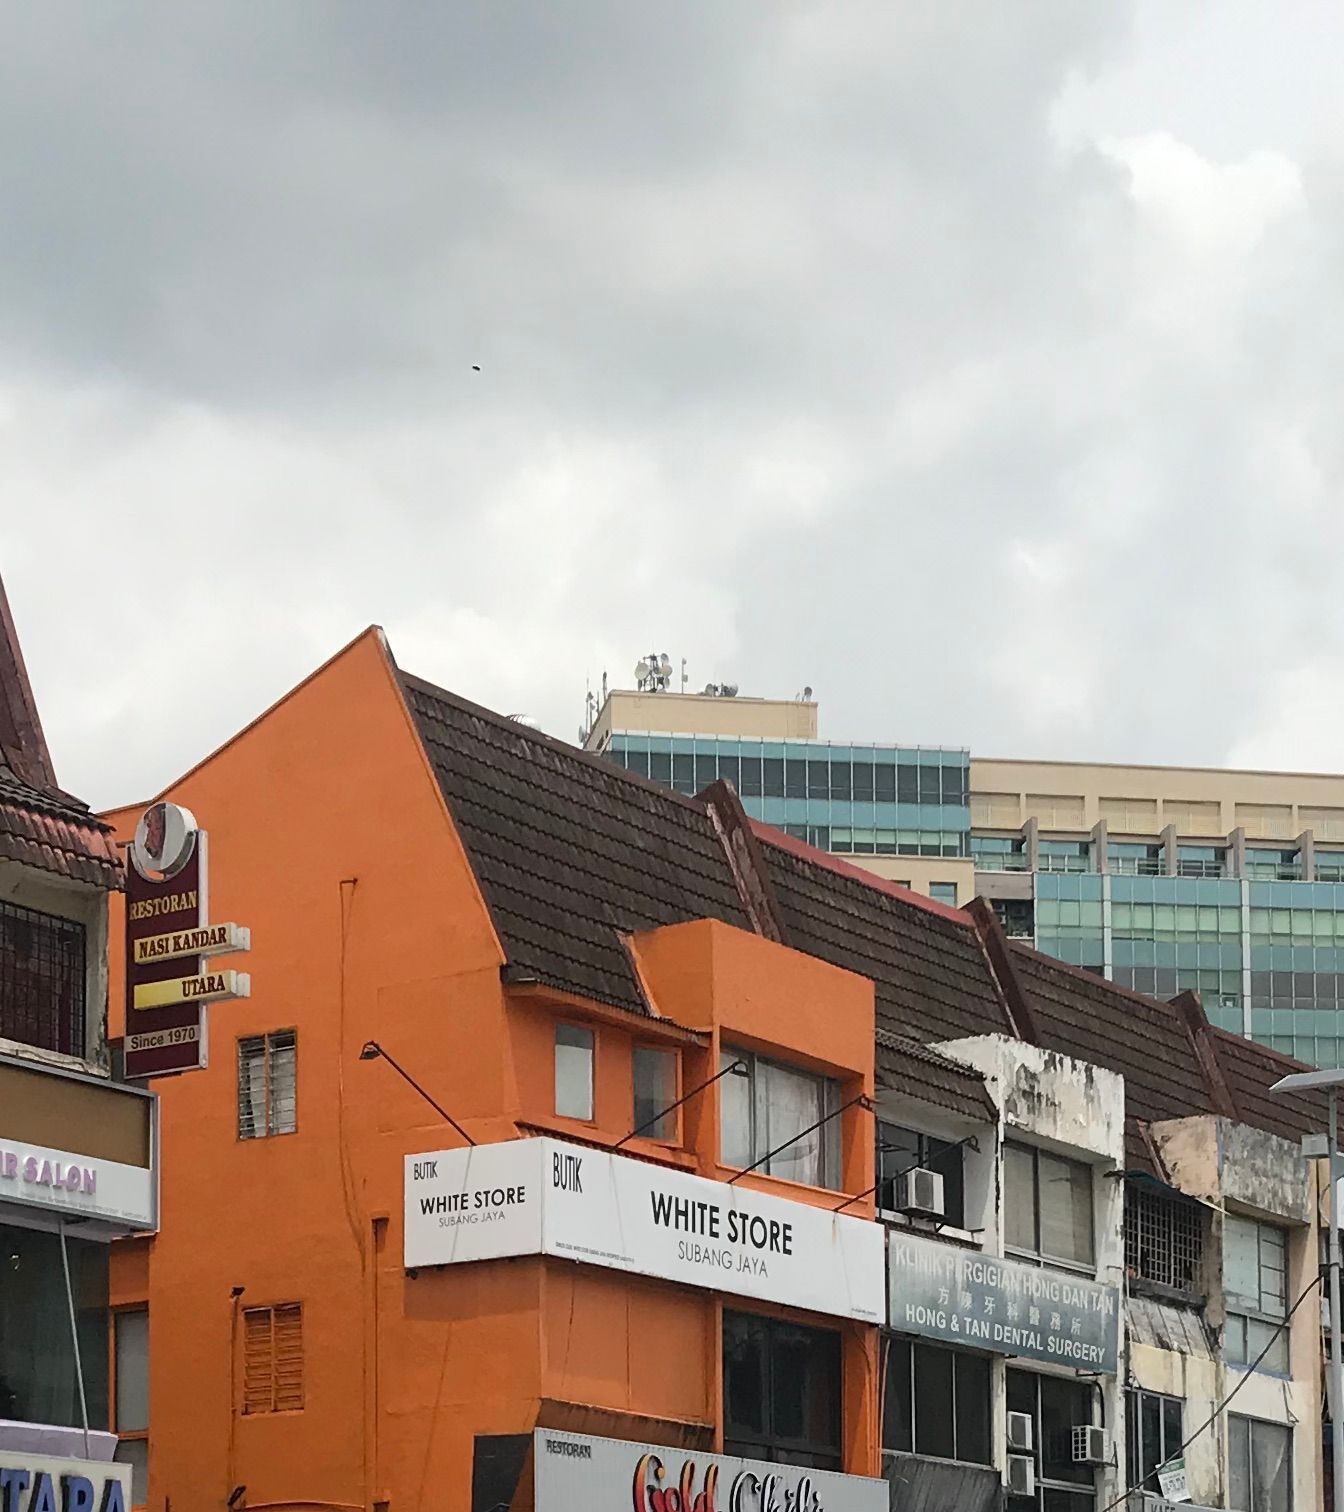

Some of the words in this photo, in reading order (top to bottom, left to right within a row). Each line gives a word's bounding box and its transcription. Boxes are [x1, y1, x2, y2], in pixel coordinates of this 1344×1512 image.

[129, 891, 197, 920] RESTORAN
[139, 938, 169, 959] NASI
[172, 927, 227, 952] KANDAR
[182, 974, 226, 997] UTARA
[130, 1035, 164, 1050] Since
[167, 1026, 196, 1044] 1970
[23, 1156, 97, 1194] SALON
[414, 1161, 438, 1181] BUTIK
[553, 1152, 583, 1194] BUTIK
[420, 1193, 470, 1215] WHITE
[474, 1186, 526, 1209] STORE
[438, 1212, 479, 1228] SUBANG
[481, 1210, 506, 1223] JAYA
[651, 1190, 719, 1238] WHITE
[727, 1212, 793, 1255] STORE
[678, 1240, 733, 1271] SUBANG
[736, 1254, 768, 1278] JAYA
[945, 1257, 1019, 1292] PRGIGIAN
[1022, 1275, 1059, 1302] HONG
[1062, 1285, 1088, 1308] DAN
[1090, 1292, 1114, 1316] TAN
[906, 1304, 946, 1329] HONG
[950, 1314, 960, 1332] &
[964, 1317, 989, 1339] TAN
[994, 1323, 1044, 1351] DENTAL
[1047, 1336, 1106, 1364] SURGERY
[546, 1439, 591, 1458] RESTORAN
